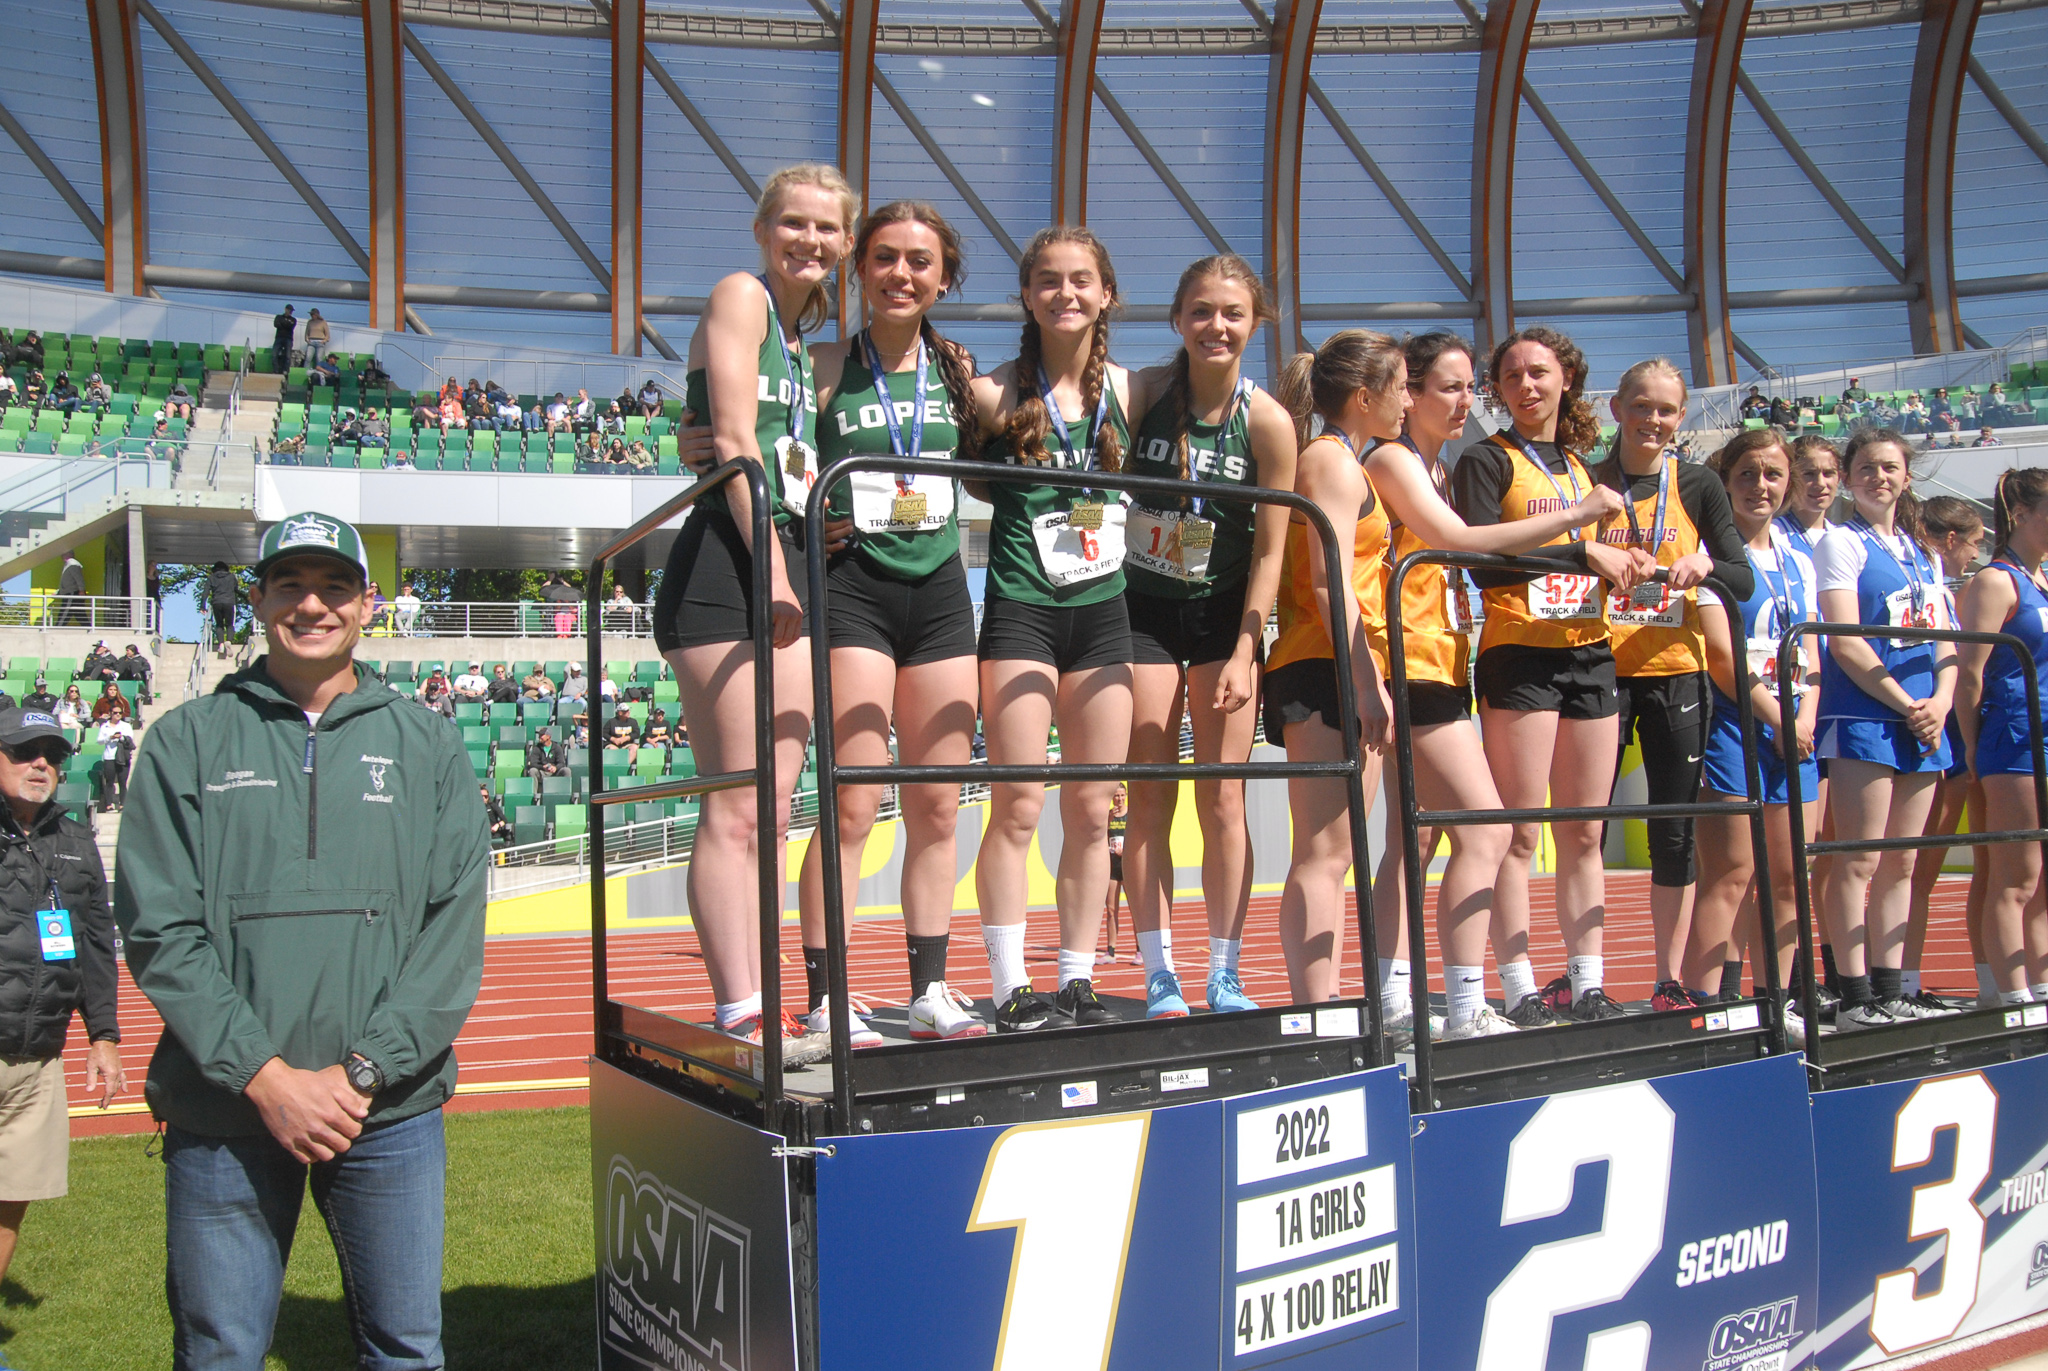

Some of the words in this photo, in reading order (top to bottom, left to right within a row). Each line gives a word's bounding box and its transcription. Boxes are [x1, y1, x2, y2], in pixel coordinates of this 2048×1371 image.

[918, 515, 945, 525] IELD
[1601, 528, 1678, 544] AMASCUS
[1131, 551, 1159, 568] TRACK
[1159, 562, 1166, 570] &
[1168, 565, 1195, 577] FIED
[1540, 607, 1569, 615] TRACK
[1578, 606, 1597, 614] FIELD
[1546, 574, 1592, 604] 522
[1901, 603, 1936, 629] 43
[363, 792, 394, 803] Football
[1162, 1073, 1189, 1083] BIL-JAX
[1276, 1105, 1330, 1163] 2022
[1276, 1198, 1303, 1248] 1A
[1310, 1181, 1366, 1240] GIRLS
[1870, 1070, 1999, 1357] 3
[2002, 1167, 2048, 1216] THIR
[965, 1111, 1152, 1371] 1
[1476, 1080, 1675, 1371] 2
[605, 1158, 749, 1371] OSAA
[1676, 1219, 1789, 1288] SECOND
[609, 1282, 633, 1328] STATE
[1238, 1298, 1253, 1345] 4
[1260, 1292, 1275, 1341] X
[1283, 1278, 1325, 1333] 100
[1332, 1259, 1391, 1320] RELAY
[1708, 1296, 1799, 1360] OSAA
[1708, 1357, 1731, 1371] STATE
[1731, 1338, 1790, 1364] CHAMPIONSHIPS
